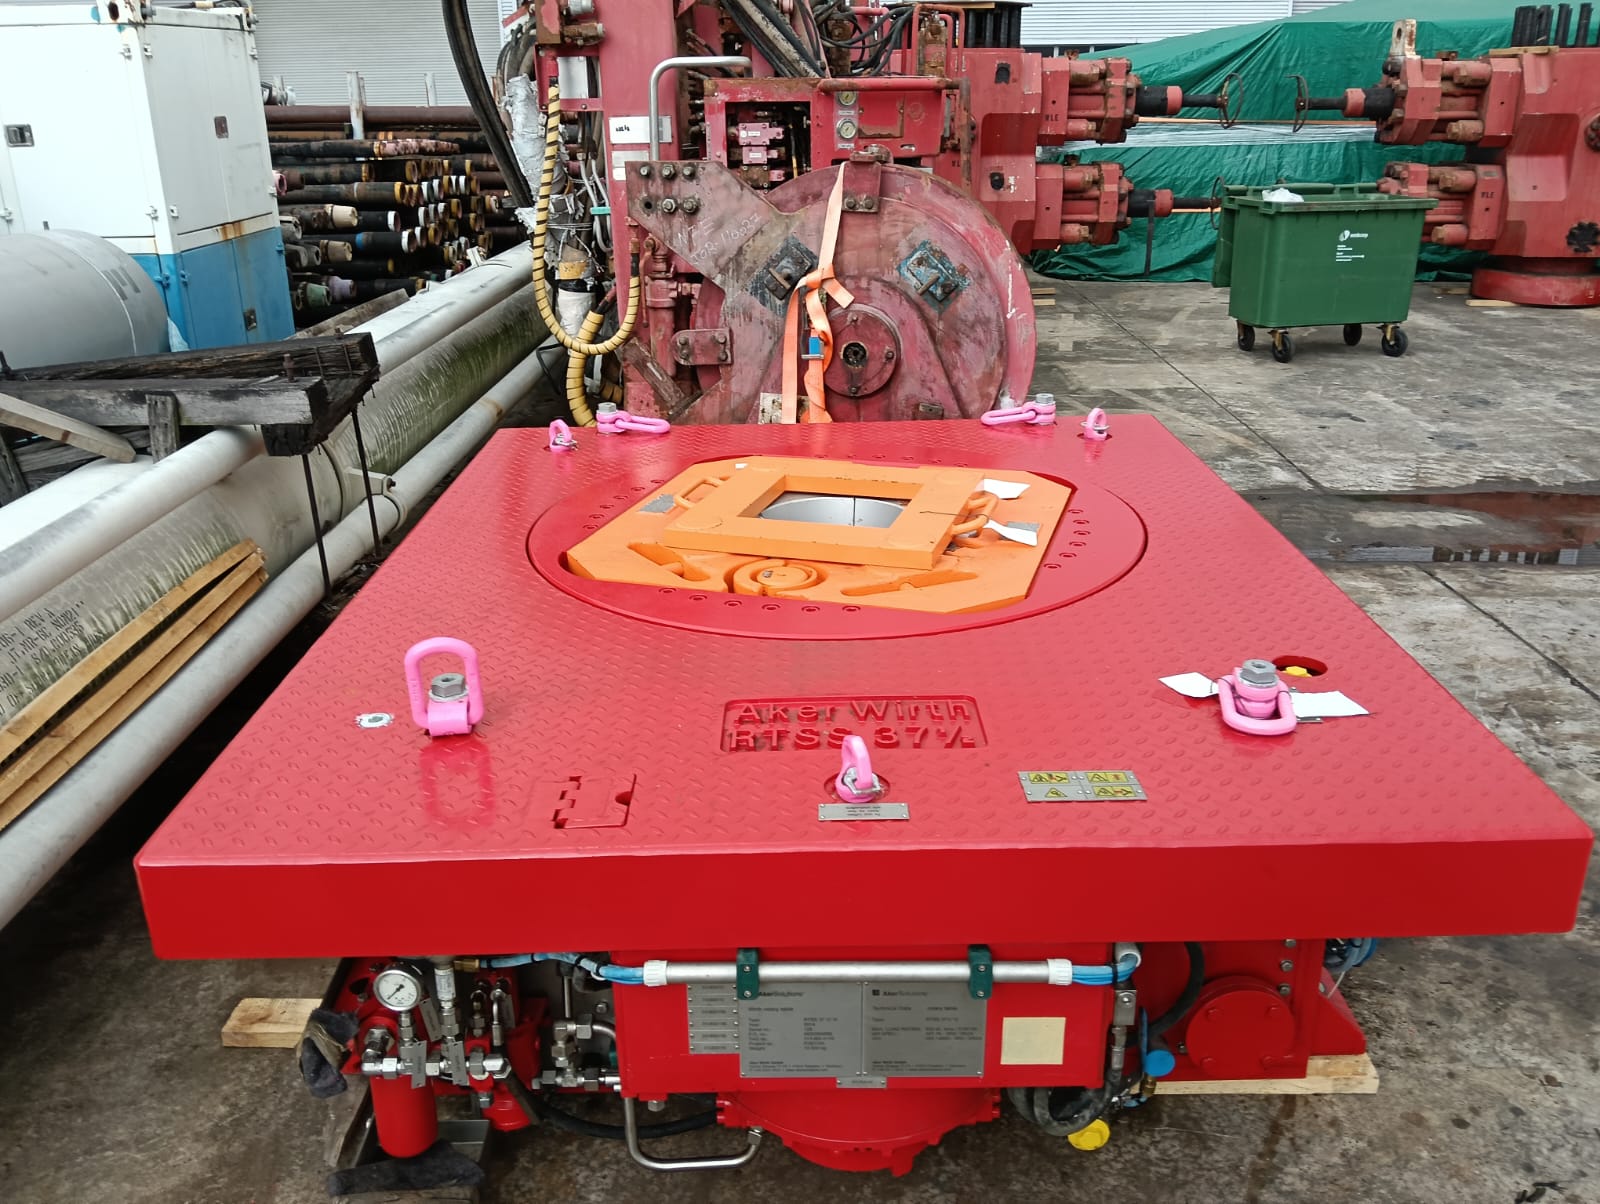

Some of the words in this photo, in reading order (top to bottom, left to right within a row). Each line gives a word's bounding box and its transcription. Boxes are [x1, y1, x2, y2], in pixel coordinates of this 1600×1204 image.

[734, 703, 837, 726] Aker
[850, 700, 971, 723] Wirth
[729, 726, 853, 752] RTSS
